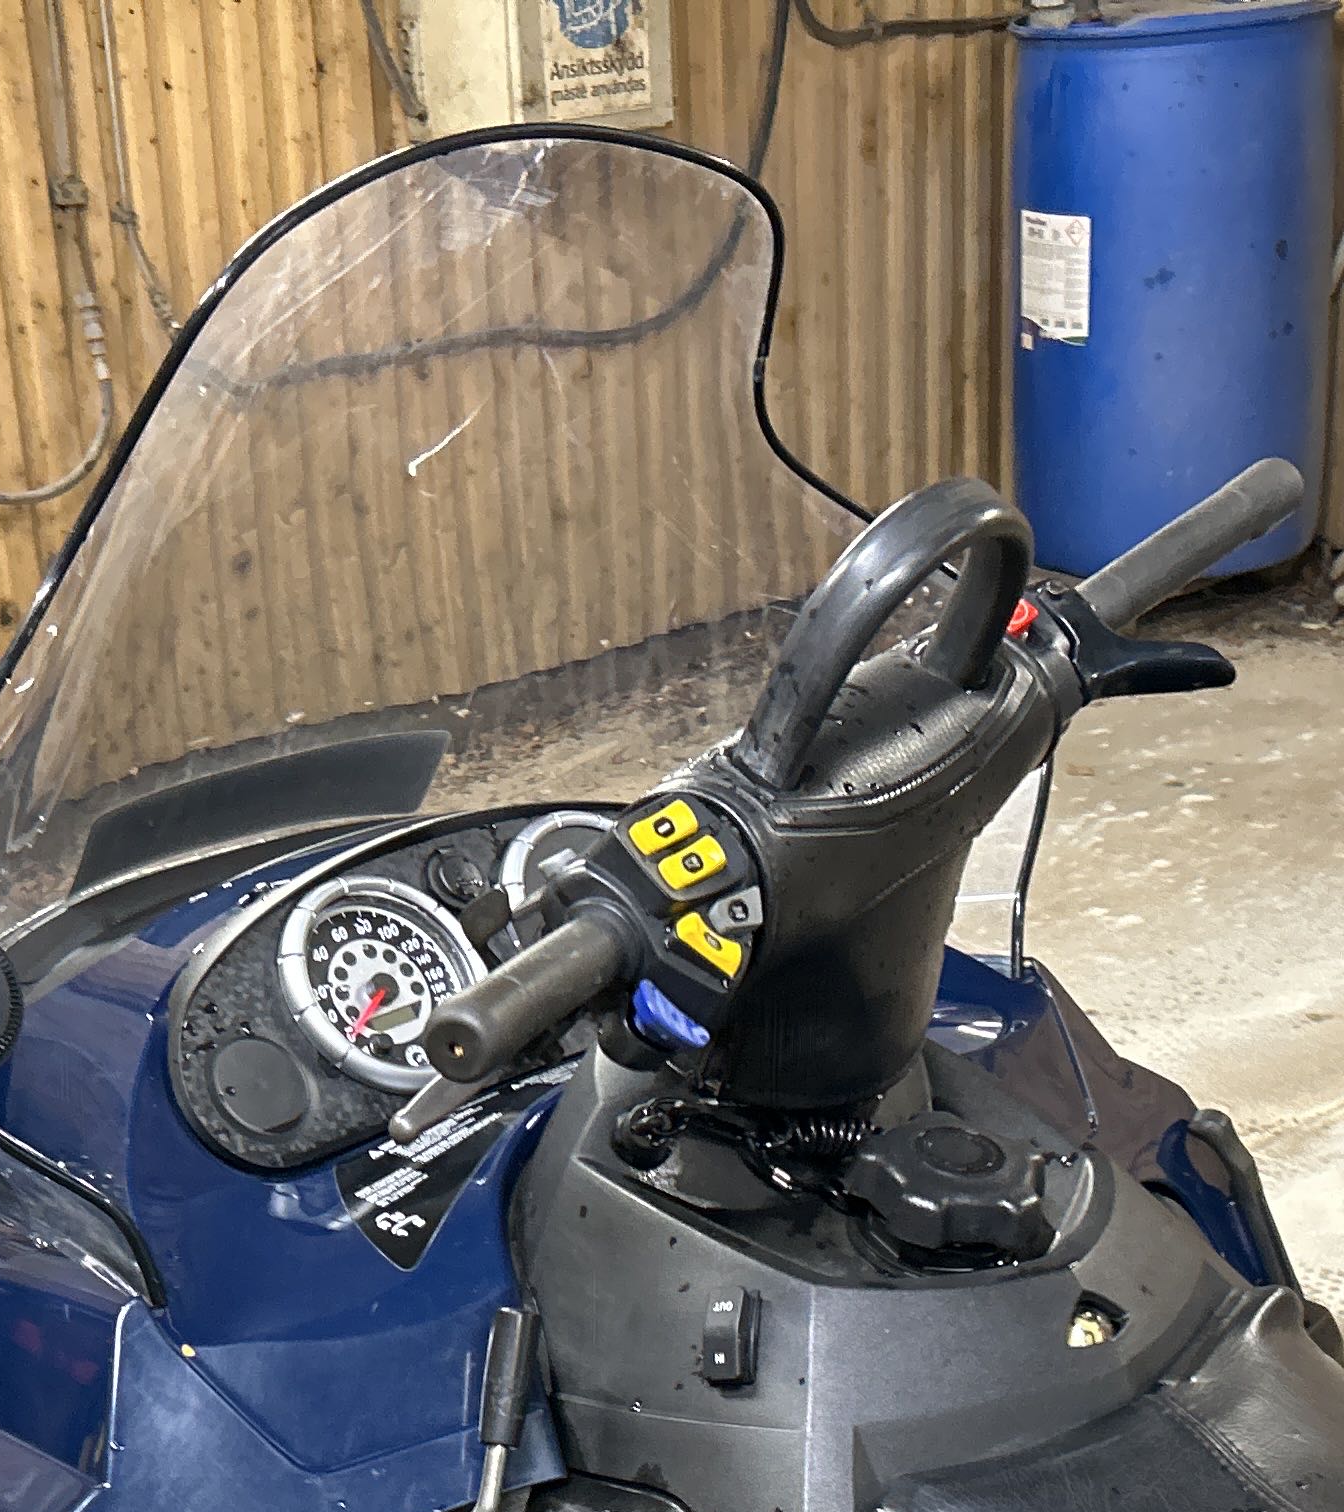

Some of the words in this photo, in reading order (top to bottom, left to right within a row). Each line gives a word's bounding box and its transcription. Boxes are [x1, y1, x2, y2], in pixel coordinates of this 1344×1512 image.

[331, 926, 348, 942] 60
[377, 924, 400, 941] 100
[313, 946, 329, 963] 40
[424, 966, 444, 983] 160
